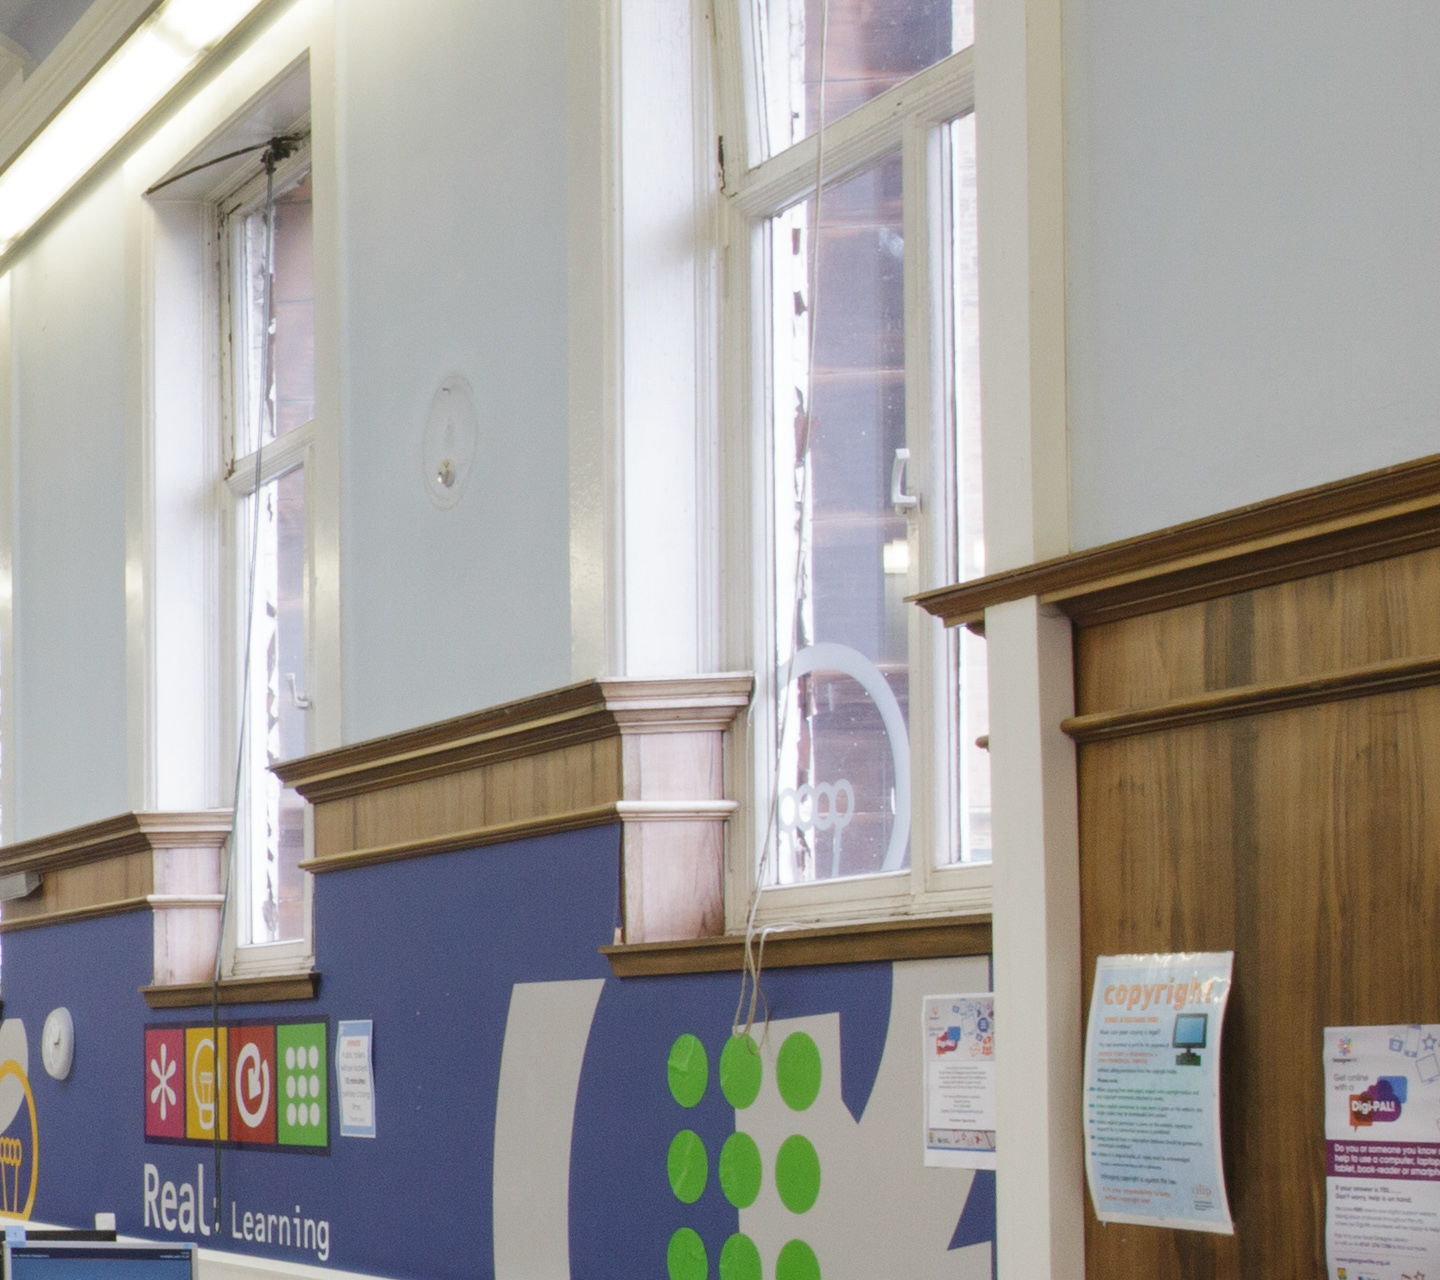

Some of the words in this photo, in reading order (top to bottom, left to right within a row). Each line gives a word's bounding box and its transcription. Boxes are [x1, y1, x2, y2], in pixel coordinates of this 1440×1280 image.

[1104, 976, 1213, 1011] copyright
[1333, 1073, 1347, 1081] Get
[1347, 1073, 1368, 1081] online
[1351, 1100, 1395, 1114] Digi-PAL!
[1334, 1144, 1344, 1152] Do
[1345, 1146, 1359, 1154] you
[1368, 1146, 1401, 1154] someone
[1402, 1147, 1416, 1155] you
[1417, 1146, 1437, 1155] know
[1334, 1154, 1350, 1164] help
[1351, 1155, 1358, 1163] to
[1357, 1165, 1401, 1174] book-reader
[232, 1201, 330, 1261] Learning
